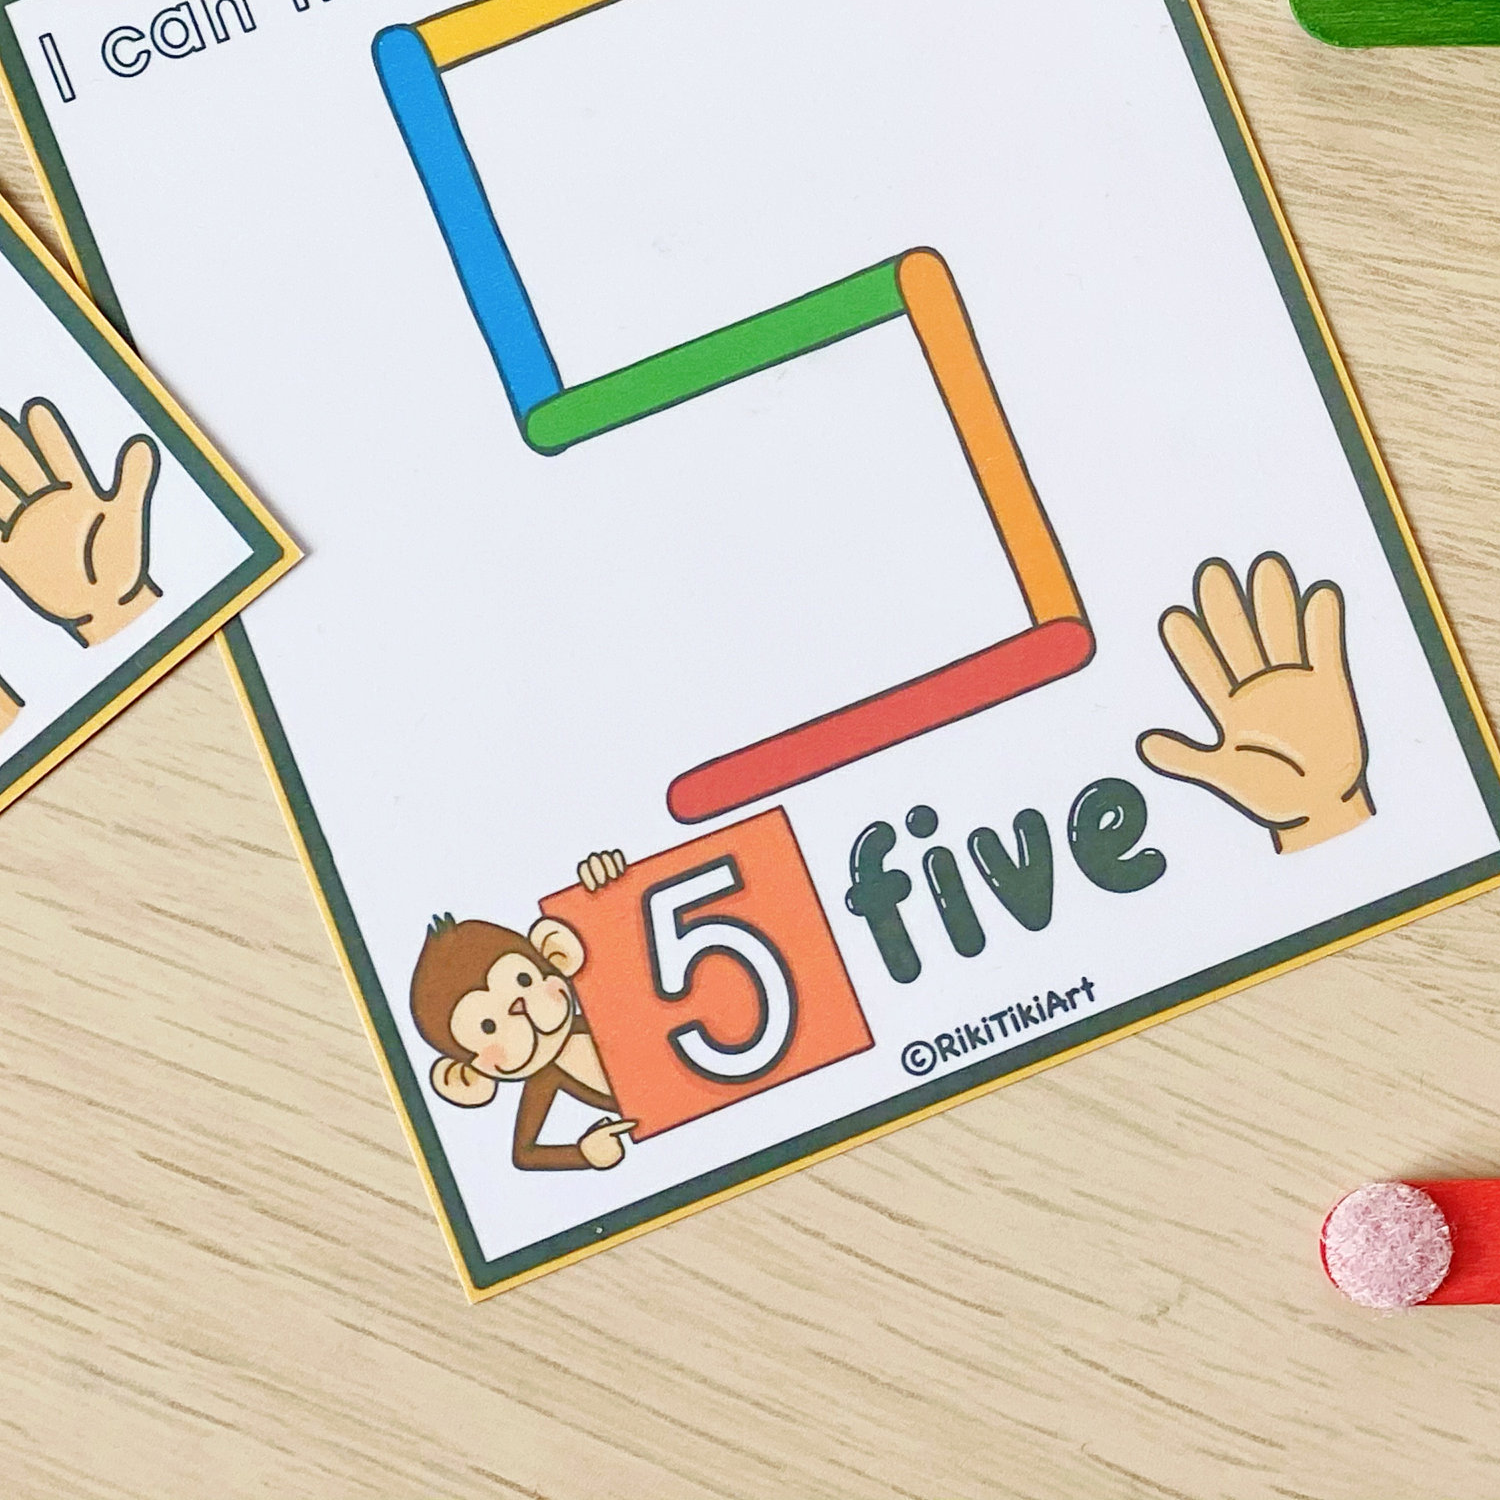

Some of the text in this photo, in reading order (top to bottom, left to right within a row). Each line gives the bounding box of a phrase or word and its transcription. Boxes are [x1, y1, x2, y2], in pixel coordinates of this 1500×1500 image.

[38, 32, 77, 104] I
[844, 777, 1167, 984] five
[640, 853, 800, 1086] 5
[901, 977, 1096, 1077] ©RikiTikiArt
